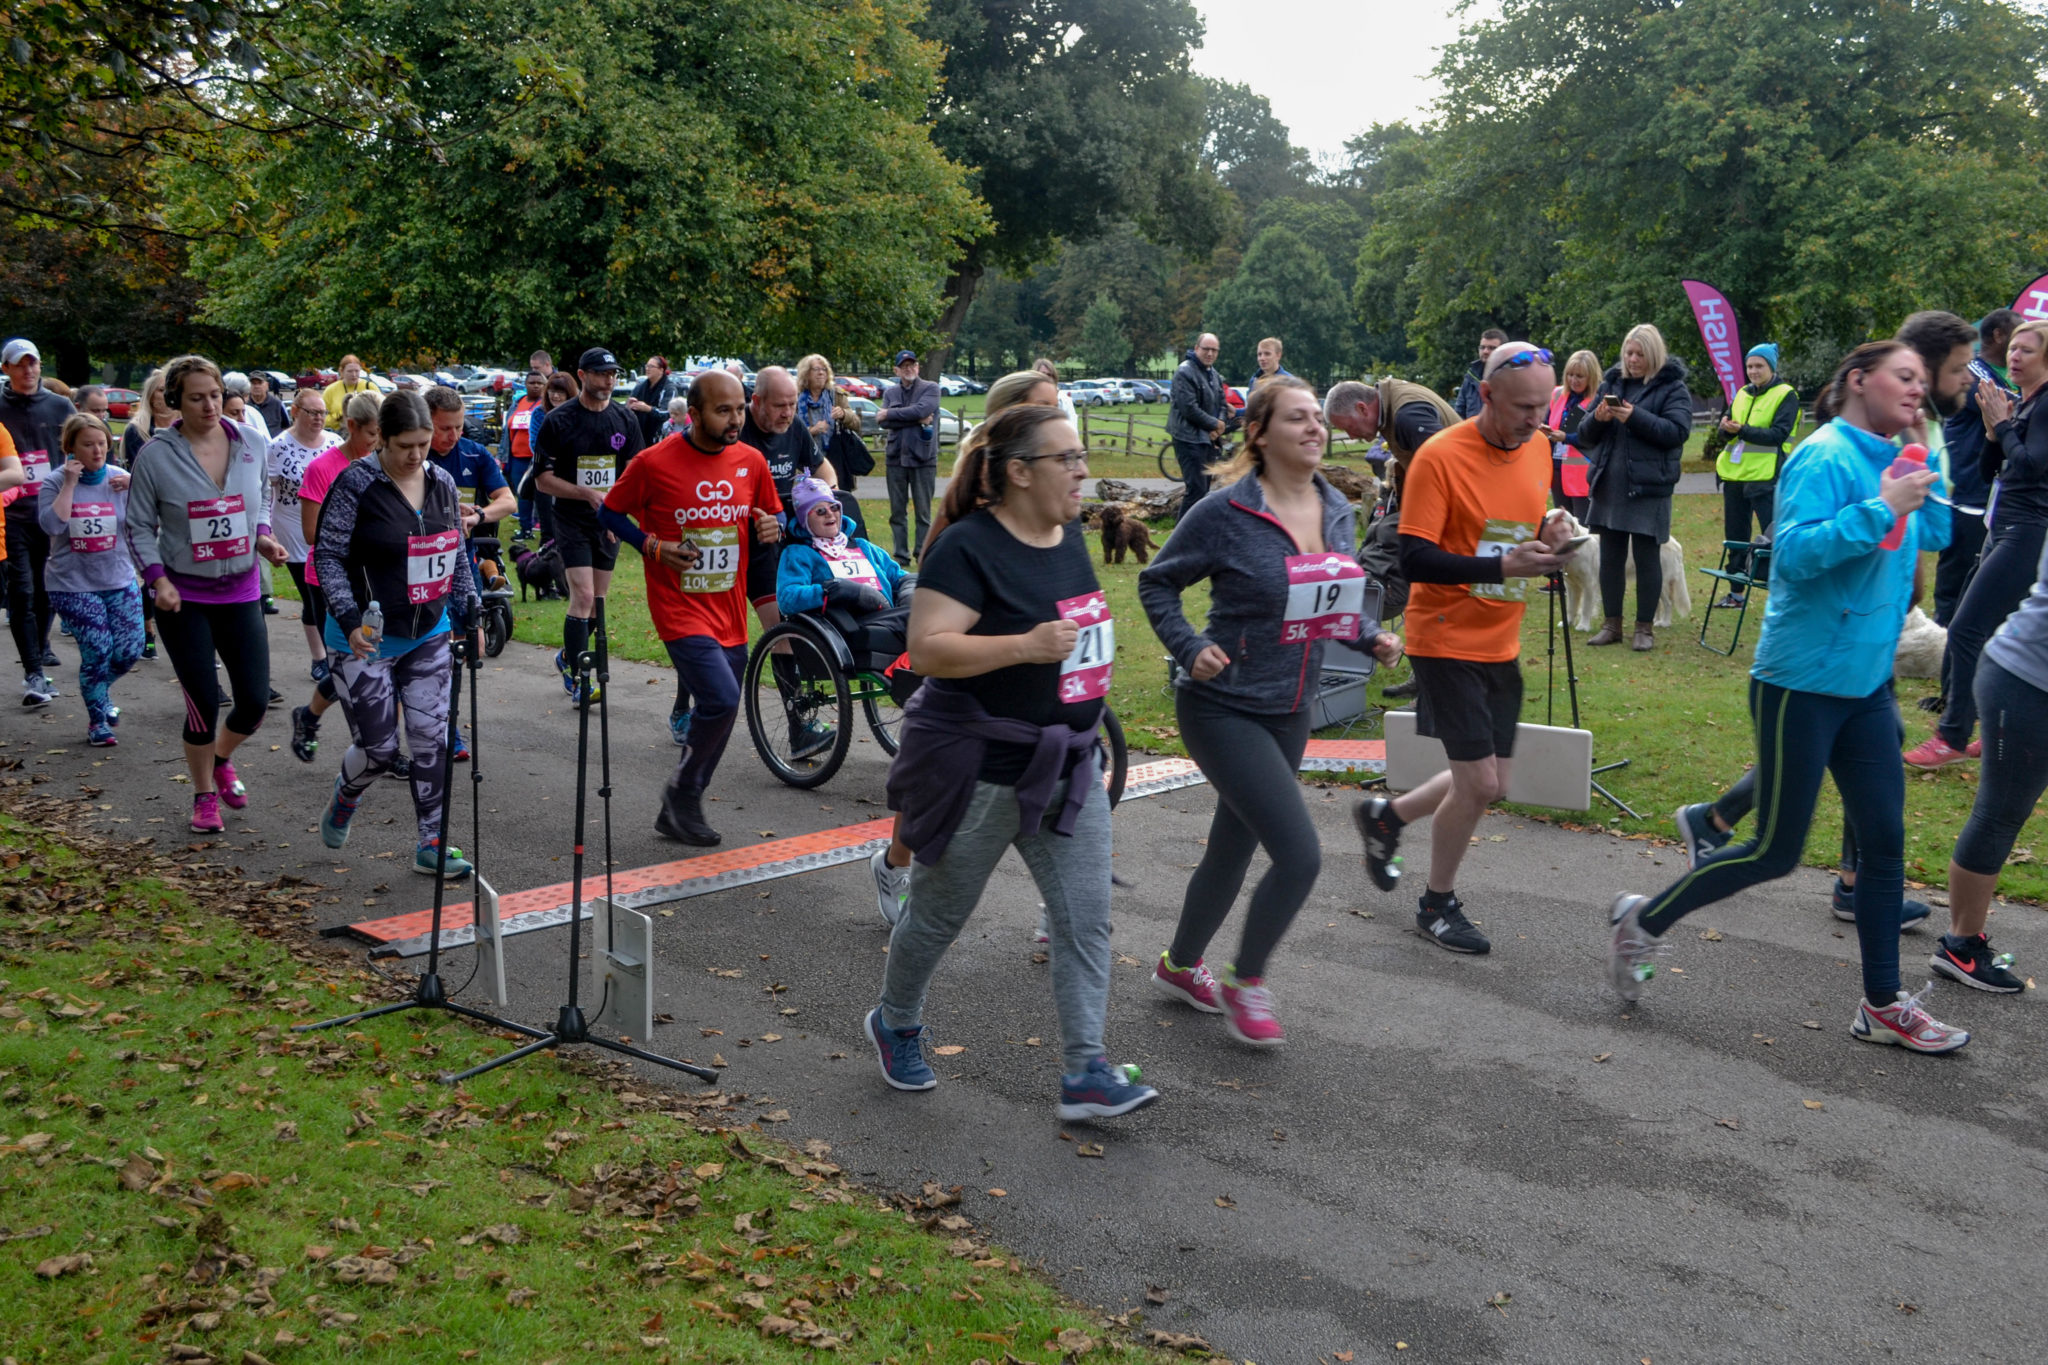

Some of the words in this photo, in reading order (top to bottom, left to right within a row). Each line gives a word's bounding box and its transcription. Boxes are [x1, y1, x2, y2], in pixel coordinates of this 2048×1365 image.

[584, 470, 609, 486] 304
[674, 502, 750, 525] goodgym
[82, 518, 103, 535] 35
[207, 517, 232, 539] 23
[73, 540, 88, 550] 5k
[197, 544, 215, 558] 5k
[428, 554, 446, 579] 15
[692, 548, 729, 571] 313
[842, 560, 861, 576] 57
[683, 576, 709, 589] 10k
[412, 586, 429, 601] 5k
[1313, 583, 1342, 614] 19
[1285, 623, 1310, 641] 5k
[1079, 626, 1103, 665] 21
[1063, 675, 1089, 699] 5k
[1428, 917, 1451, 937] N
